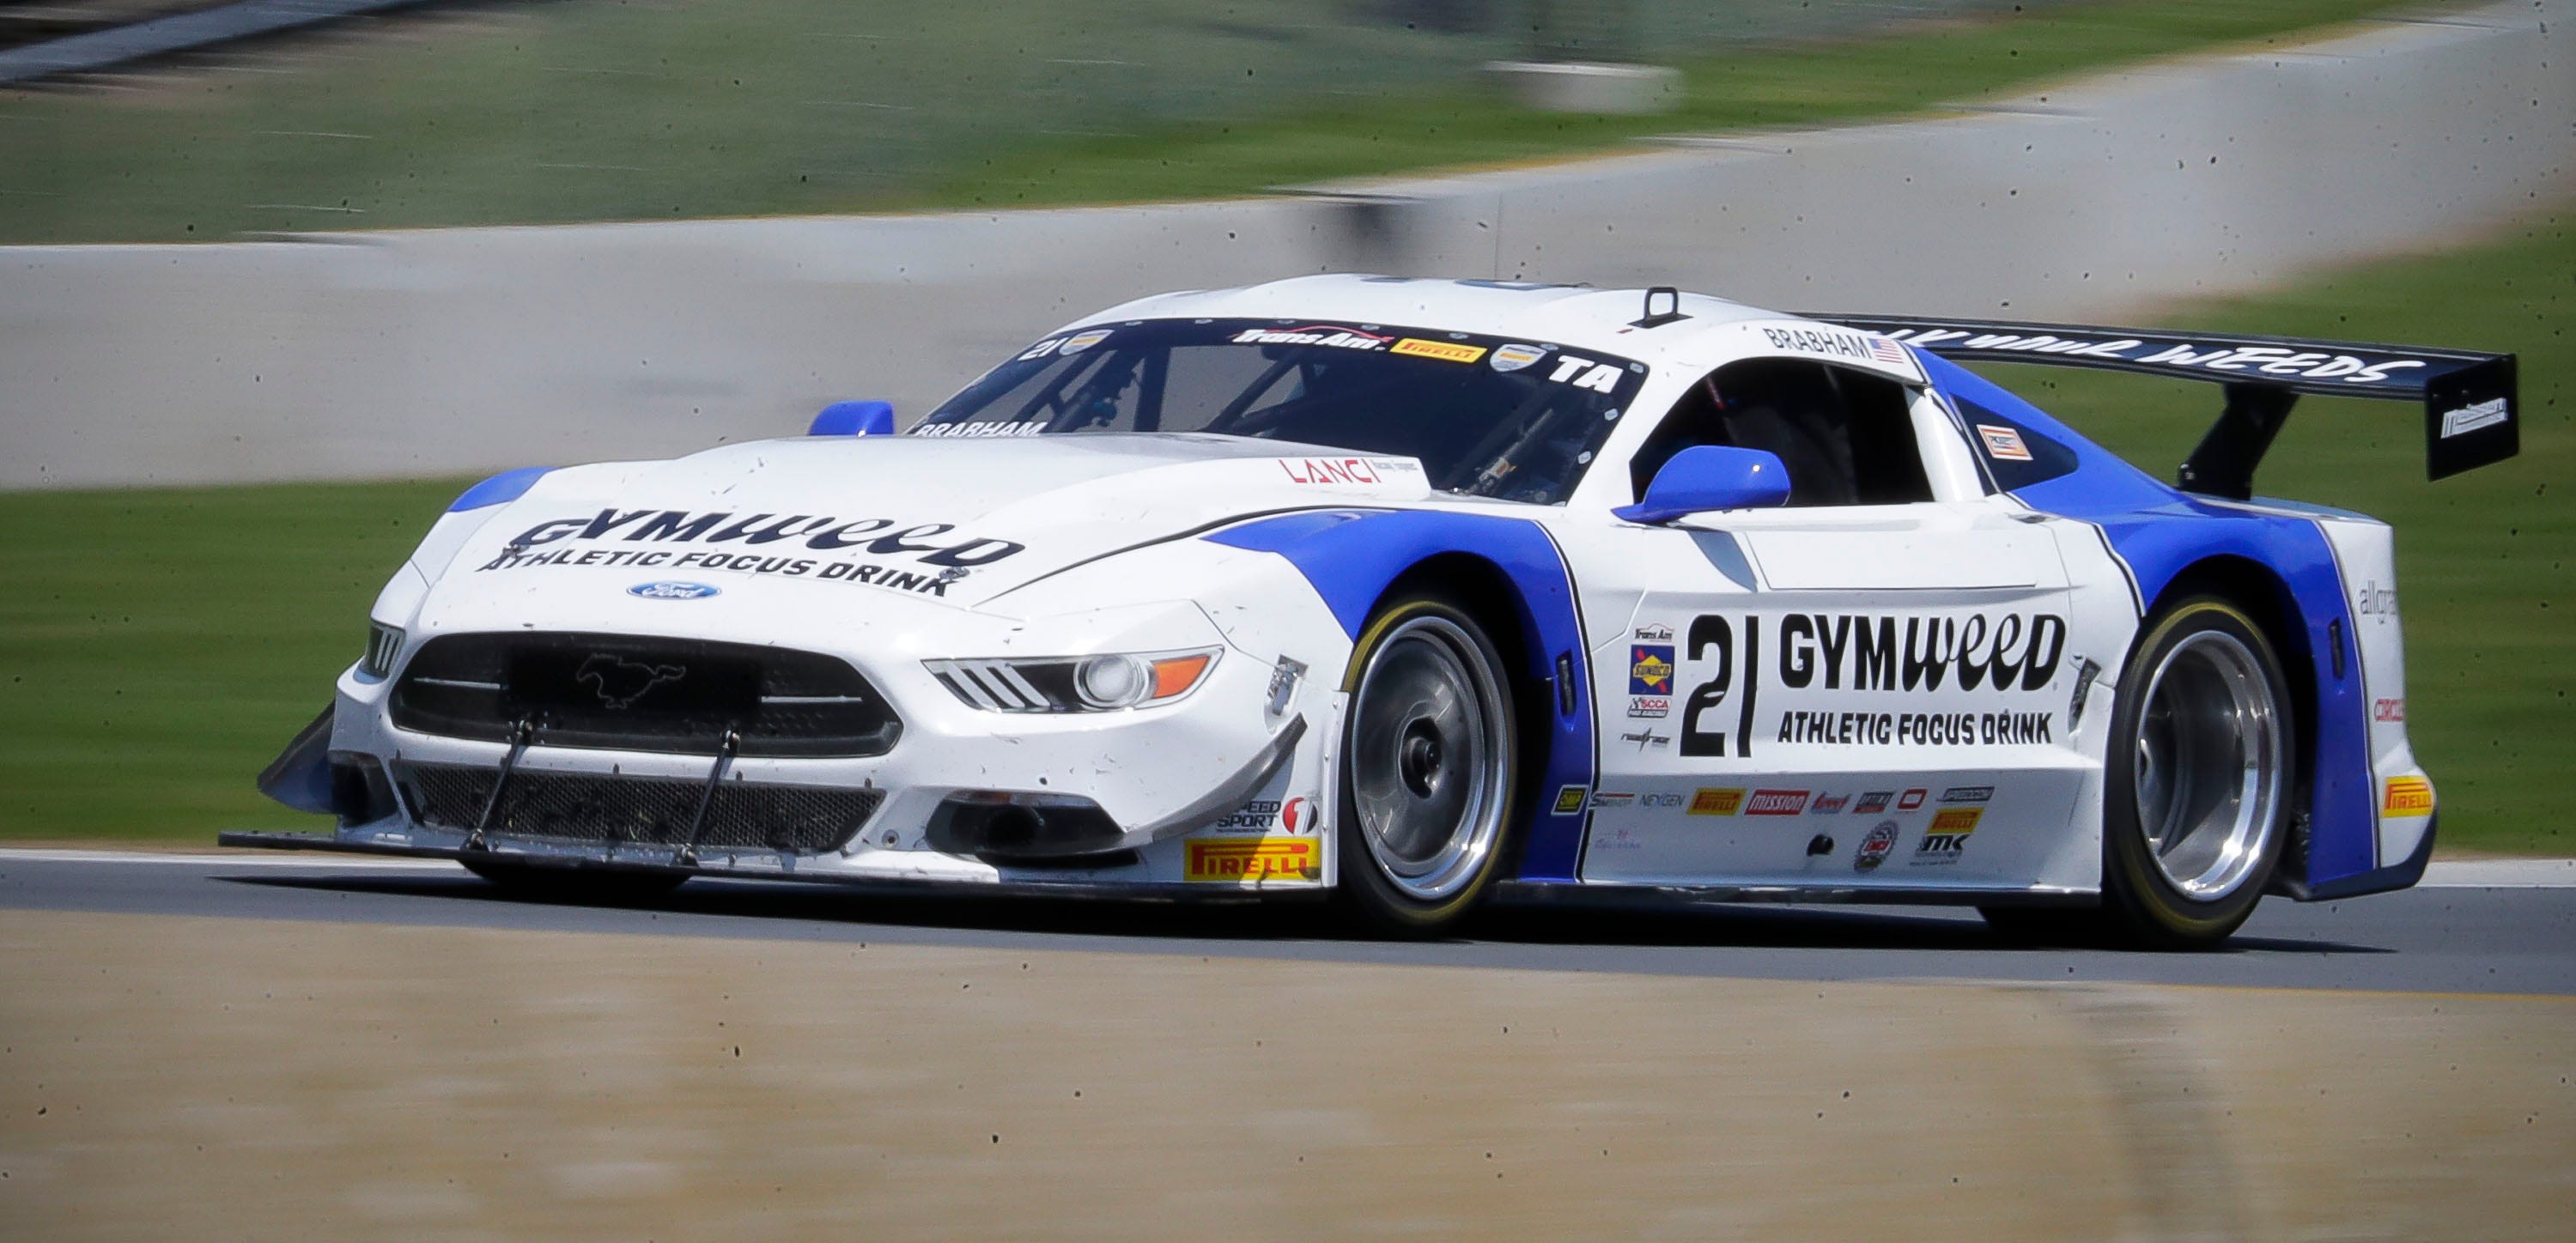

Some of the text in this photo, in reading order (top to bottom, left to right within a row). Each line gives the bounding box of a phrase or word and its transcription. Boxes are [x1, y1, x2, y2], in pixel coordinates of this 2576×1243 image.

[1017, 337, 1069, 361] 21
[1401, 342, 1475, 359] PIRELLI
[1762, 328, 1872, 359] BRABHAM
[1549, 355, 1624, 393] TA
[2135, 343, 2426, 383] WEEDS
[1279, 458, 1381, 483] LANCI
[474, 549, 960, 597] ATHLETIC FOCUS DRINK
[641, 583, 705, 598] Ford
[1680, 615, 1759, 757] 21
[1641, 699, 1668, 709] SCCA
[1777, 711, 2053, 745] ATHLETIC FOCUS DRINK
[1217, 815, 1278, 828] SPORT
[1191, 843, 1309, 875] PIRELLI
